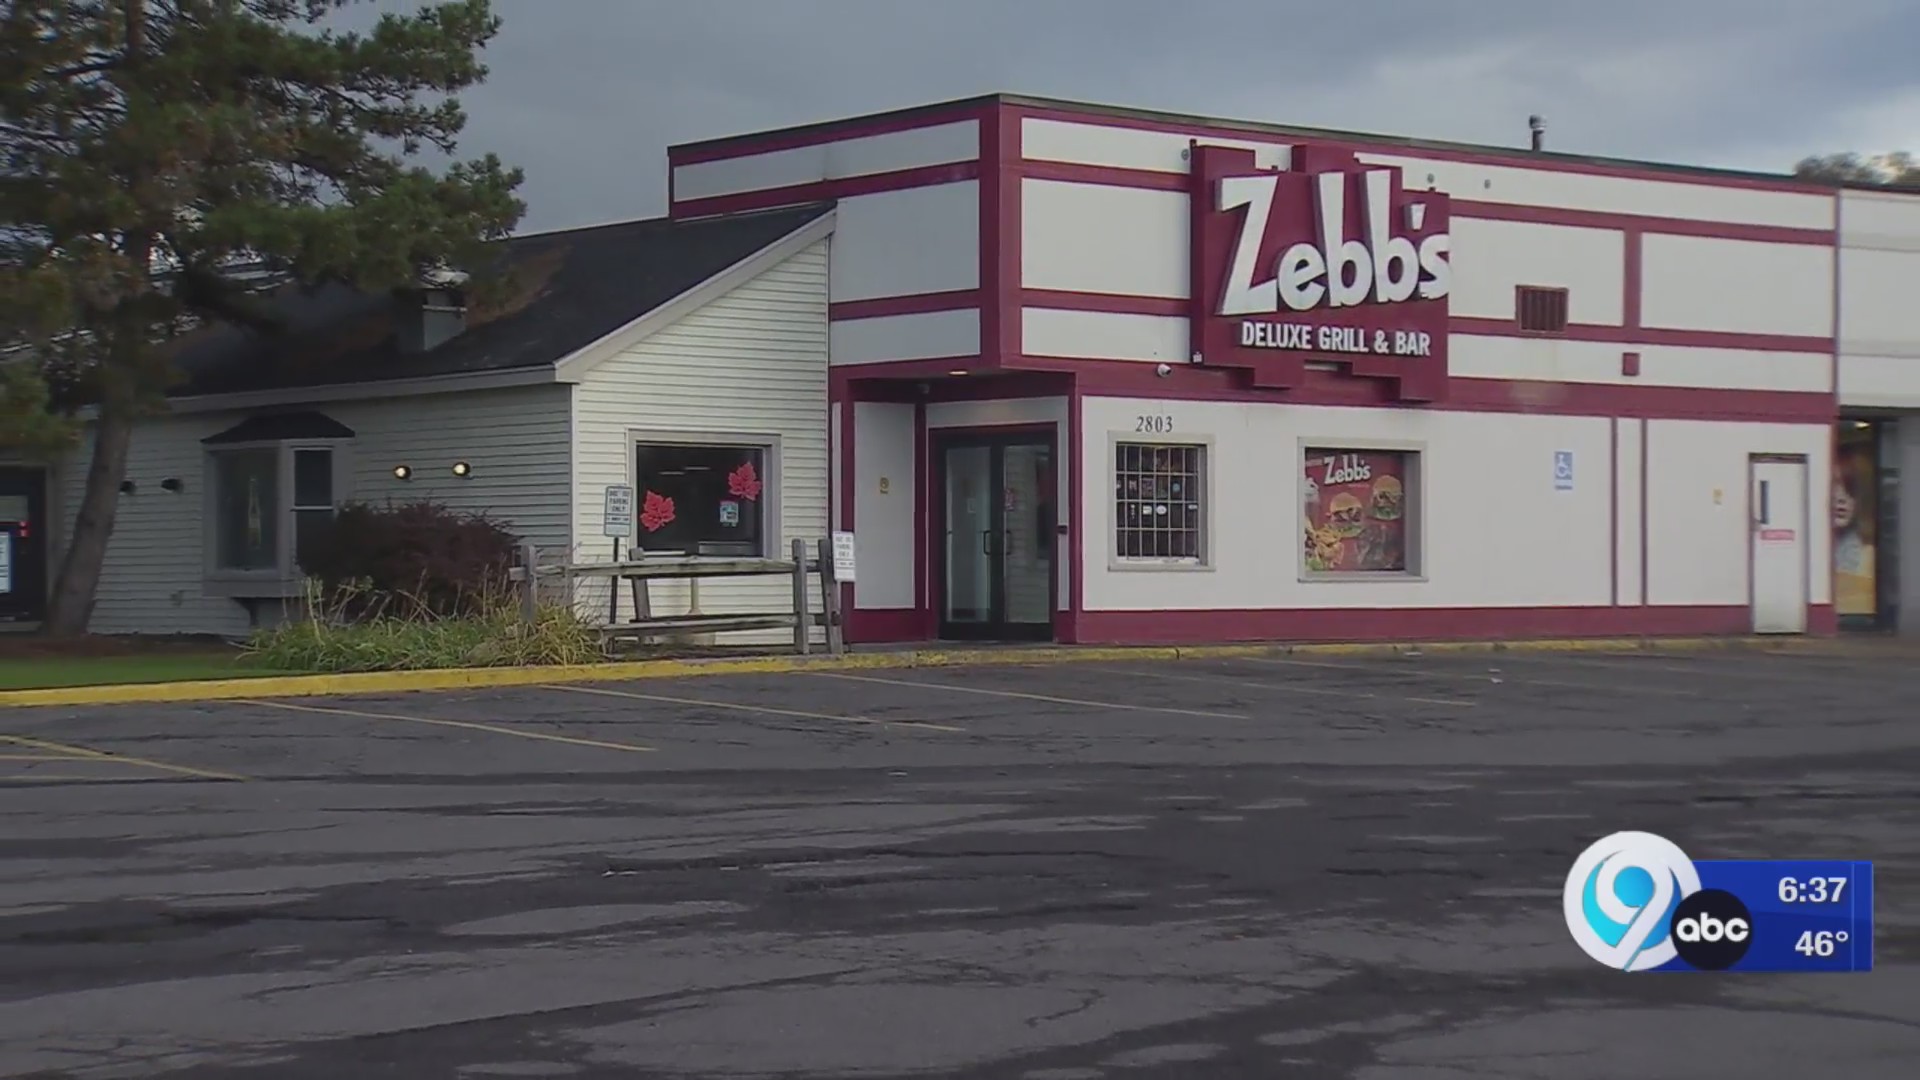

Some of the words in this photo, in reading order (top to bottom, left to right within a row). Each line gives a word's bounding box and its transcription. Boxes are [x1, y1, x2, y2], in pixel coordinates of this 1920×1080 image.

[1216, 169, 1449, 315] Zebb's
[1242, 321, 1312, 349] DELUXE
[1318, 326, 1369, 352] GRILL
[1374, 330, 1389, 354] &
[1395, 331, 1430, 356] BAR
[1135, 416, 1172, 433] 2803
[1323, 454, 1371, 485] Zebb's
